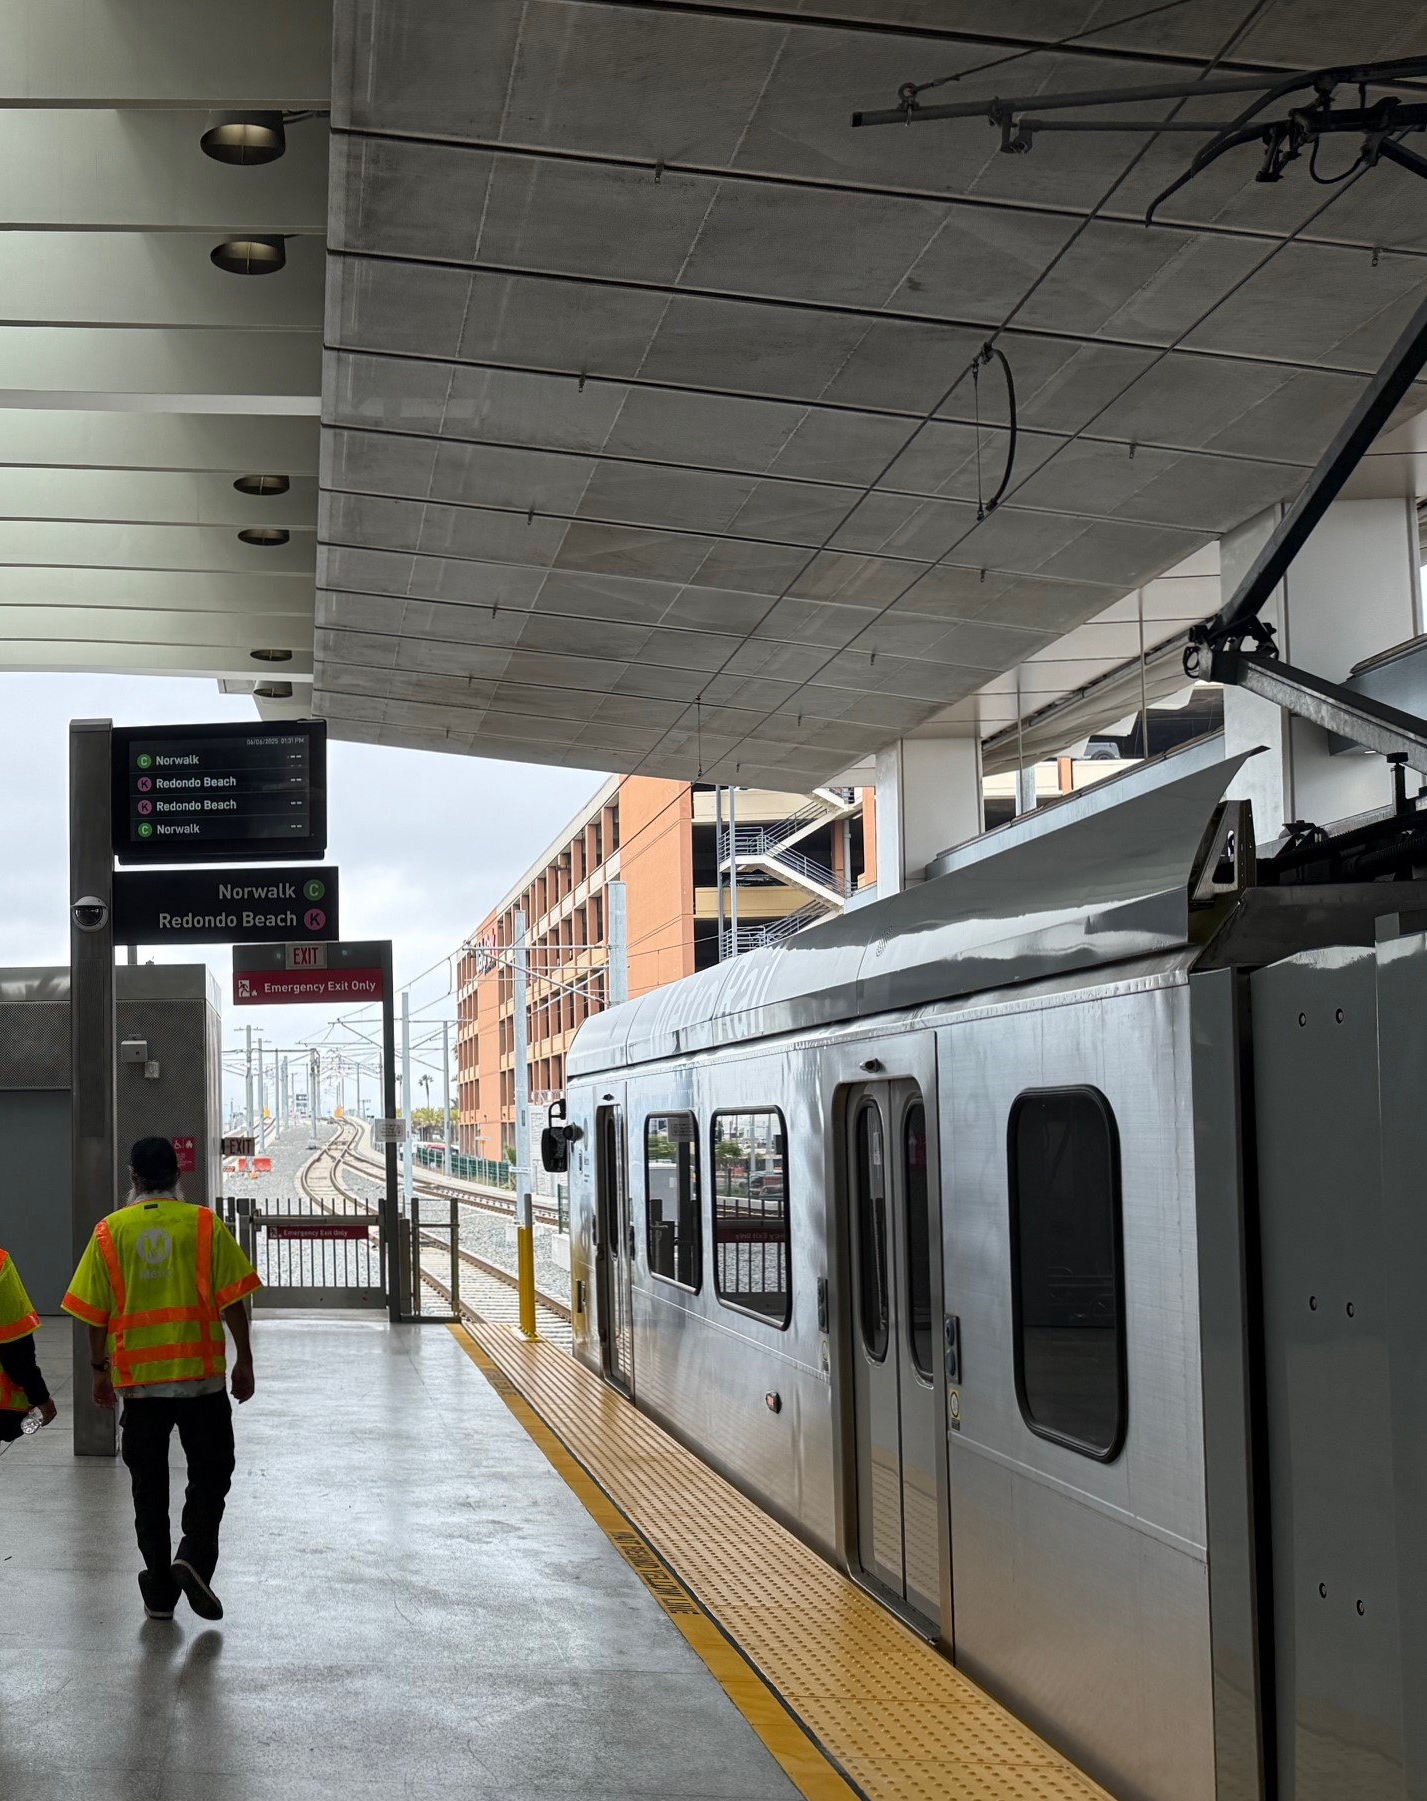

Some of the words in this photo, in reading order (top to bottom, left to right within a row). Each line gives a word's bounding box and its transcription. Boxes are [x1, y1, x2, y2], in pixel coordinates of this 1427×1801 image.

[156, 755, 199, 766] Norwalk
[156, 778, 201, 788] Redondo
[204, 776, 236, 787] Beach
[156, 800, 201, 812] Redondo
[204, 799, 237, 810] Beach
[157, 824, 200, 835] Norwalk
[219, 883, 296, 900] Norwalk
[159, 912, 237, 929] Redondo
[243, 911, 297, 927] Beach
[293, 947, 318, 965] EXIT
[264, 982, 325, 994] Emergency
[328, 980, 349, 992] Exit
[352, 980, 376, 992] Only
[230, 1140, 251, 1154] EXIT
[334, 1229, 348, 1237] Only
